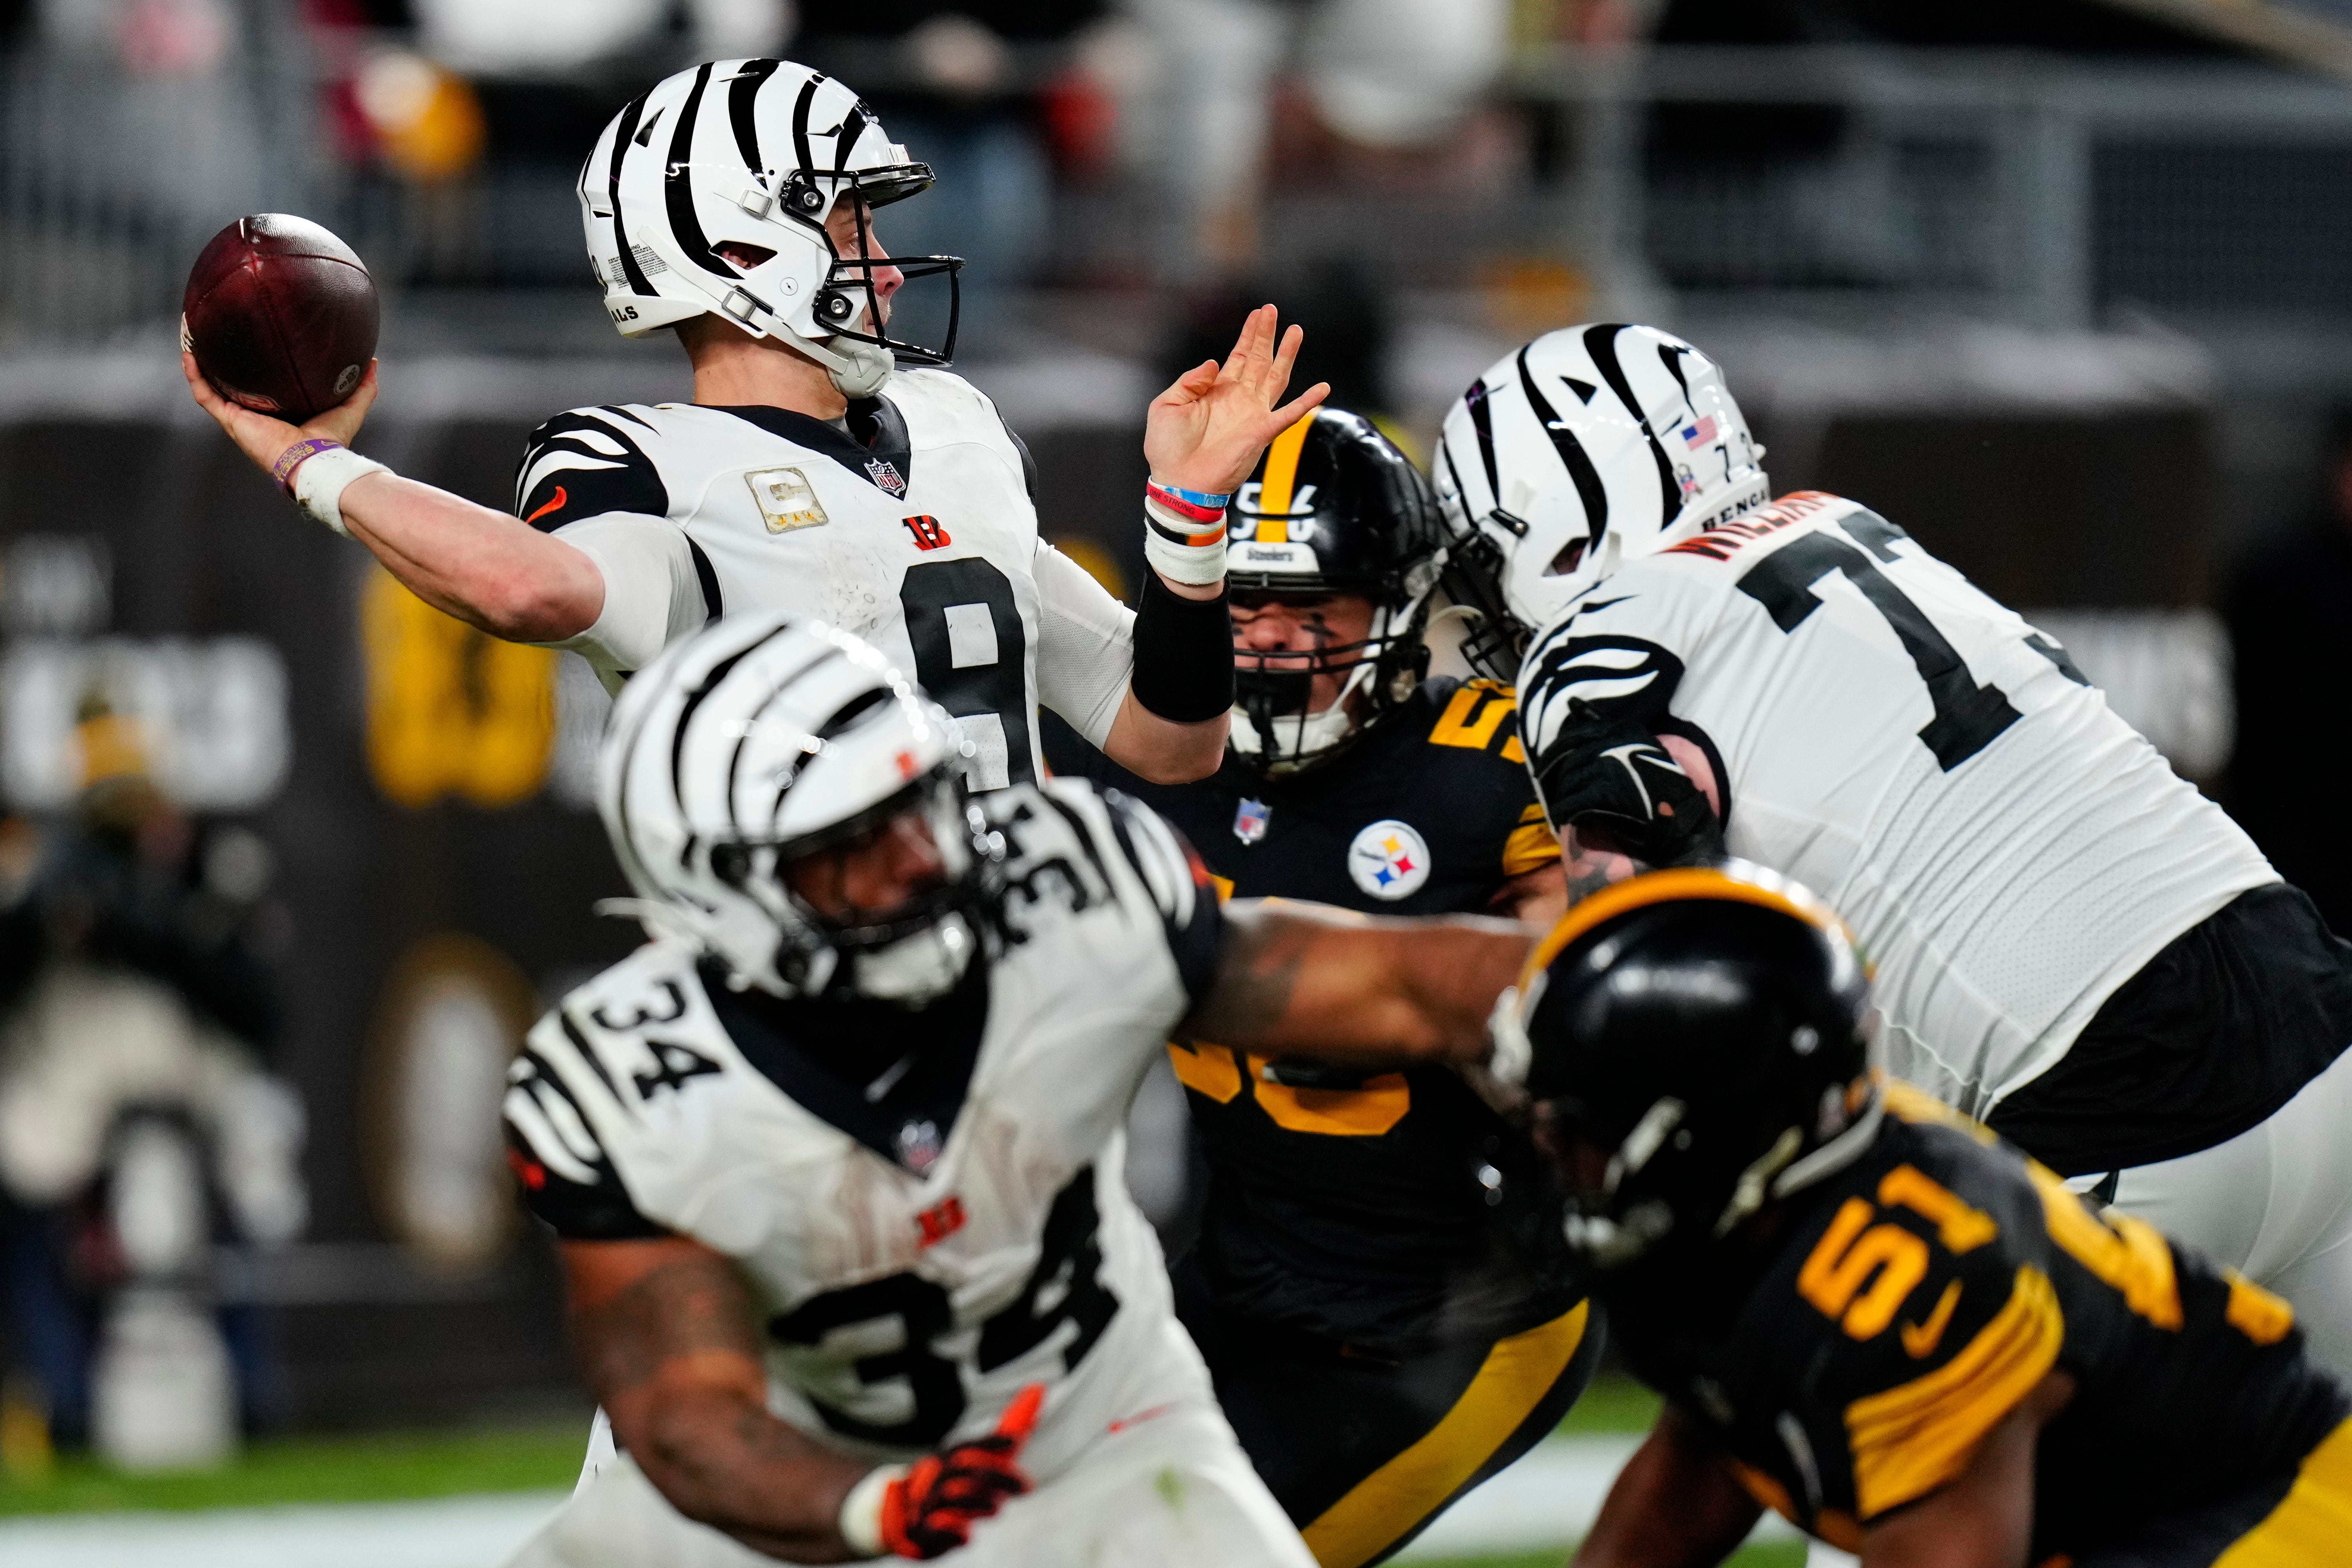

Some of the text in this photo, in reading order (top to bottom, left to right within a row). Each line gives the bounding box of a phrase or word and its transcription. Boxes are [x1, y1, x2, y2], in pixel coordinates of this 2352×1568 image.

[752, 471, 814, 515] C
[877, 474, 901, 488] NFL
[1150, 489, 1162, 500] ONE
[1164, 494, 1195, 515] STRONG
[901, 514, 954, 552] B
[1229, 482, 1319, 543] 56
[592, 980, 723, 1101] 34
[1796, 1164, 1997, 1342] 51
[770, 1167, 1120, 1449] 34
